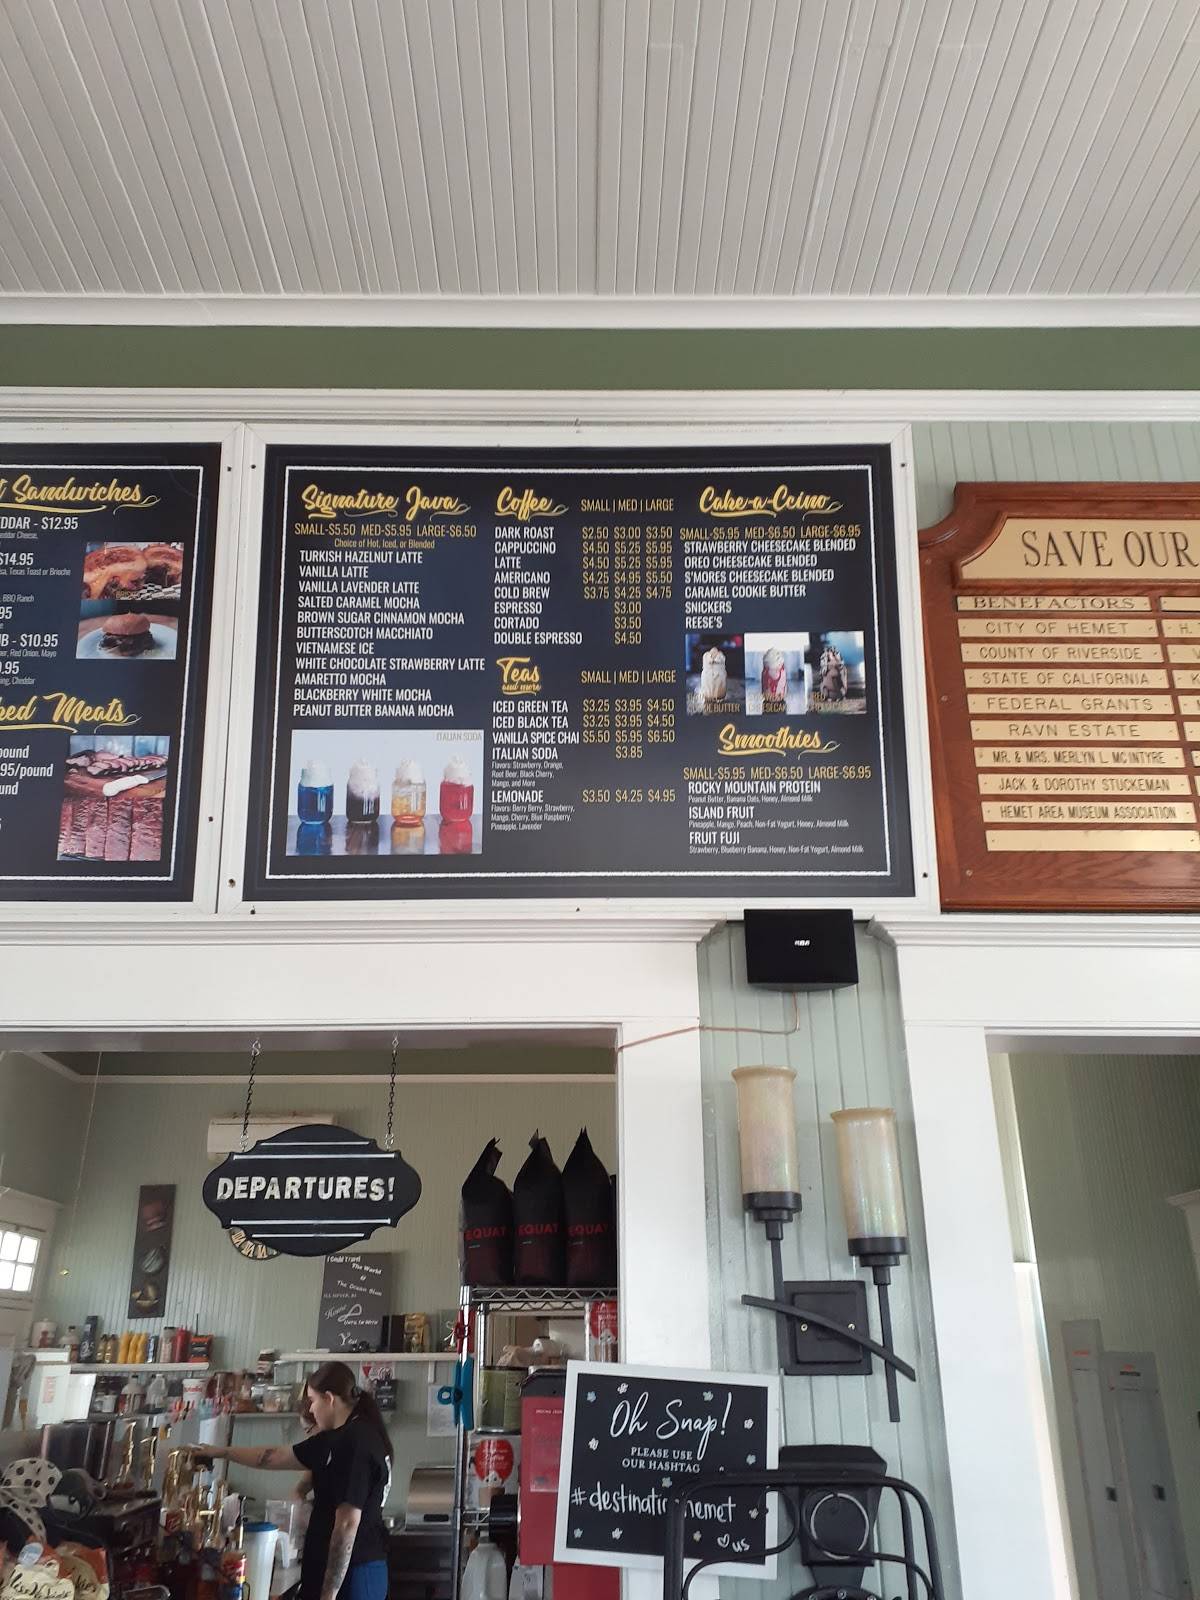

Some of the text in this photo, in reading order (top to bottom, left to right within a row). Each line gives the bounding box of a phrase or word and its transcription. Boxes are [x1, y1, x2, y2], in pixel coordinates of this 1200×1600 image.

[12, 474, 142, 503] Sandwiches
[301, 484, 459, 521] Signature Java
[495, 486, 552, 521] Coffee
[581, 499, 674, 511] SMALL MED LARGE
[0, 517, 78, 529] DDAR $12.95
[294, 524, 476, 536] SMALL-$5.50 MED-$5.95 LARGE-$6.50
[494, 527, 553, 539] DARK ROAST
[582, 526, 672, 539] $2.50 $3.00 $3.50
[679, 525, 860, 540] SMALL-$5.95 MED-$6.50 LARGE-$6.95
[494, 542, 556, 554] CAPPUCCINO
[684, 539, 855, 553] STRAWBERRY CHEESECAKE BLENDED
[1022, 530, 1199, 567] SAVE OUR
[300, 551, 422, 563] TURKISH HAZELNUT LATTE
[494, 557, 521, 568] LATTE
[494, 572, 550, 584] AMERICANO
[684, 569, 834, 583] S'MORES CHEESECAKE BLENDED
[299, 581, 419, 594] VANILLA LAVENDER LATTE
[494, 587, 549, 599] COLD BREW
[684, 585, 805, 598] CARAMEL COOKIE BUTTER
[298, 596, 419, 608] SALTED CARAMEL MOCHA
[494, 602, 542, 614] ESPRESSO
[685, 601, 731, 613] SNICKERS
[974, 598, 1135, 609] BENEFACTORS
[297, 611, 464, 624] BROWN SUGAR CINNAMON MOCHA
[494, 617, 539, 629] CORTADO
[685, 616, 722, 629] REESE'S
[296, 627, 433, 639] BUTTERSCOTCH MACCHIATO
[985, 622, 1126, 633] CITY OF HEMET
[20, 634, 58, 647] $10.95
[494, 632, 582, 644] DOUBLE ESPRESSO
[296, 642, 374, 654] VIETNAMESE ICE
[979, 647, 1141, 660] COUNTY OF RIVERSIDE
[295, 658, 485, 671] WHITE CHOCOLATE STRAWBERRY LATTE
[496, 656, 540, 682] Teas
[294, 673, 386, 685] AMARETTO MOCHA
[982, 672, 1148, 684] STATE OF CALIFORNIA
[294, 689, 431, 701] BLACKBERRY WHITE MOCHA
[43, 693, 126, 724] Meats
[293, 704, 453, 717] PEANUT BUTTER BANANA MOCHA
[492, 700, 568, 713] ICED GREEN TEA
[987, 698, 1152, 710] FEDERAL GRANTS
[583, 729, 675, 743] $5.50 $5.95 $6.50
[1008, 724, 1139, 737] RAVN ESTATE
[492, 731, 579, 744] VANILLA SPICE CHAI
[719, 724, 821, 751] Smoothies
[492, 747, 557, 759] ITALIAN SODA
[616, 746, 642, 758] $3.85
[683, 766, 871, 780] SMALL-$5.95 MED-$6.50 LARGE-$6.95
[688, 780, 820, 794] ROCKY MOUNTAIN PROTEIN
[999, 778, 1169, 791] JACK & DOROTHY STUCKEMAN
[492, 790, 543, 802] LEMONADE
[689, 806, 754, 819] ISLAND FRUIT
[1000, 806, 1175, 818] HEMET AREA MUSEUM ASSOCIATION
[689, 832, 739, 844] FRUIT FUJI
[217, 1175, 396, 1202] DEPARTURES!
[364, 1265, 381, 1274] World
[610, 1392, 732, 1461] Oh Snap!
[631, 1447, 692, 1460] PLEASE USE
[622, 1458, 700, 1473] OUR HASHTAG
[732, 1538, 749, 1552] us
